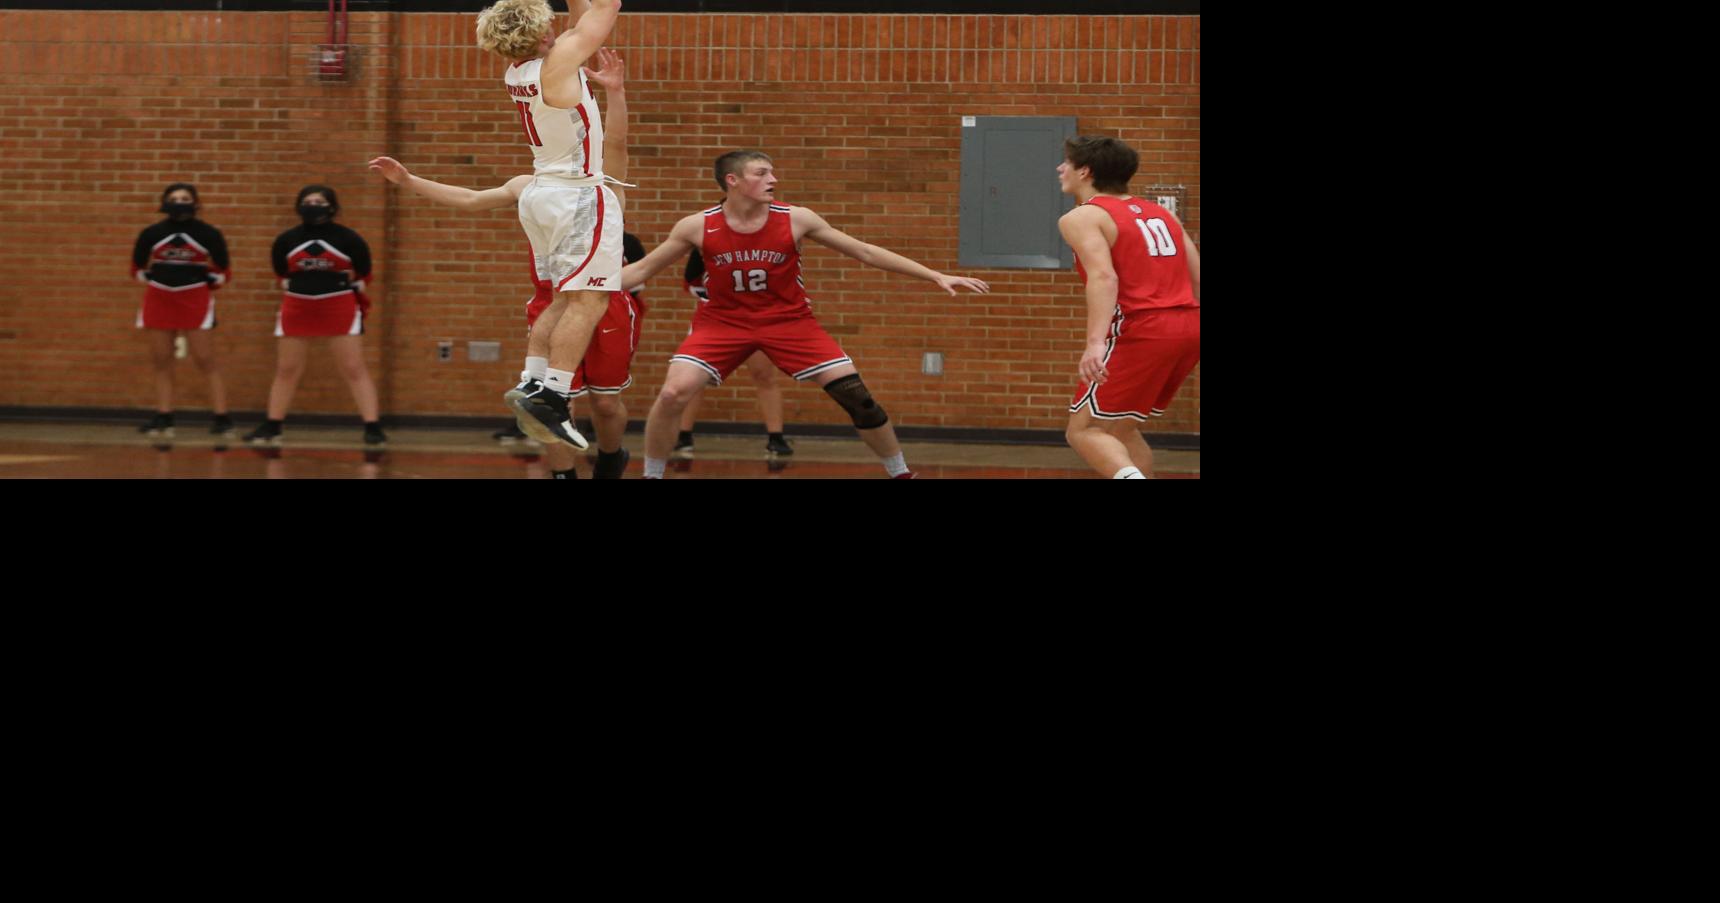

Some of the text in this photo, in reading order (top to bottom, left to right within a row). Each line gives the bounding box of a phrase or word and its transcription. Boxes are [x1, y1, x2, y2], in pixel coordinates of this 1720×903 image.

[1135, 217, 1177, 256] 10
[587, 276, 607, 287] MC
[732, 269, 768, 292] 12
